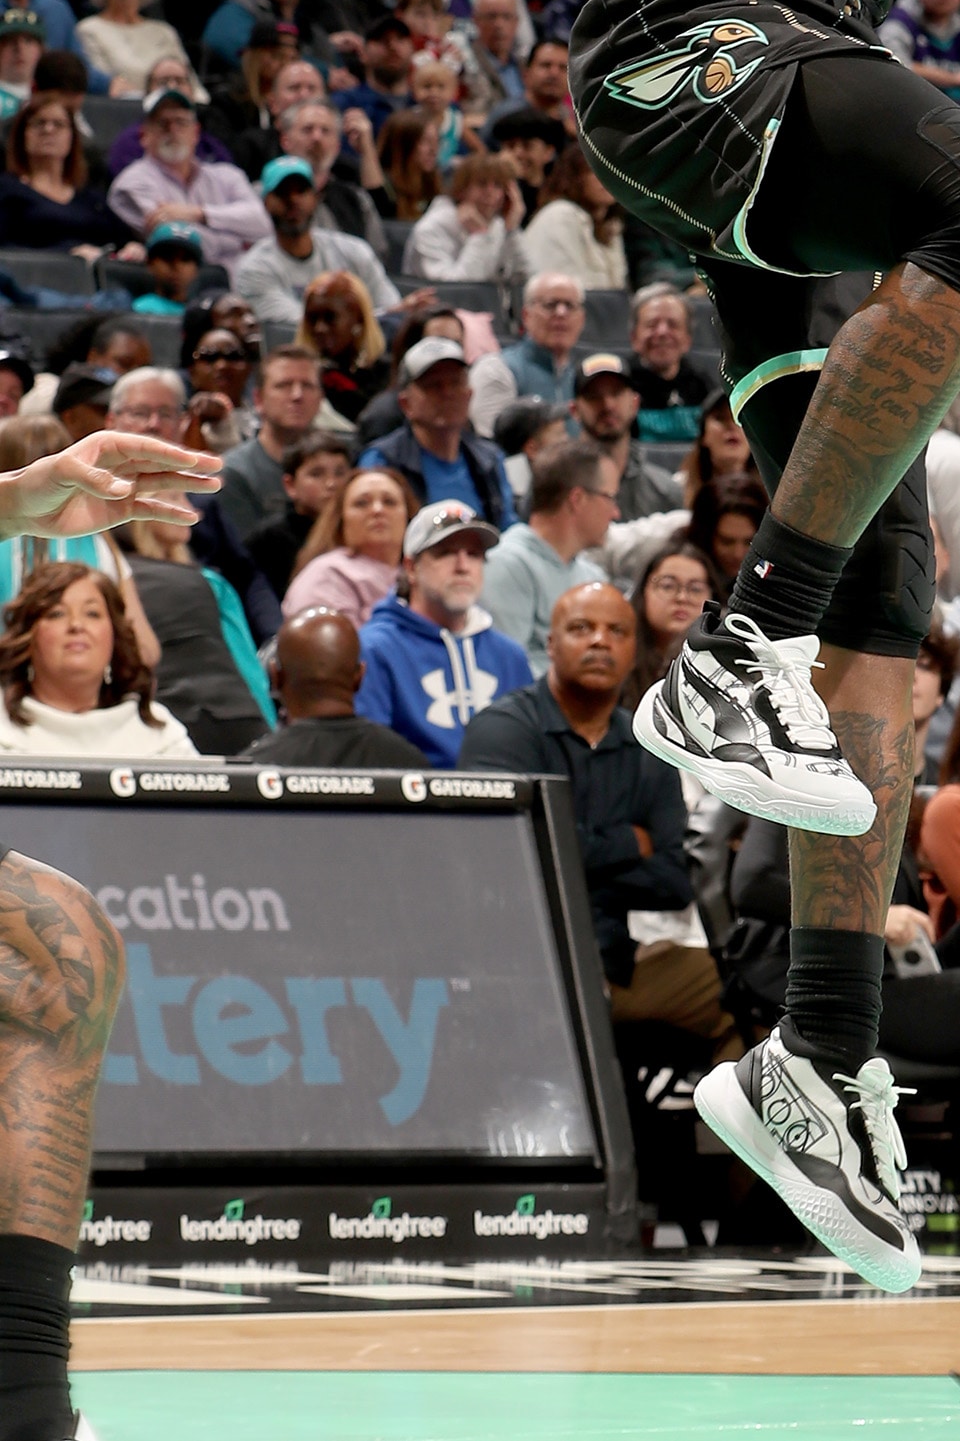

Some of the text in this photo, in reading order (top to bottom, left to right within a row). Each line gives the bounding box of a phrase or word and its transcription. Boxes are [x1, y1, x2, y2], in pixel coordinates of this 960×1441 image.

[139, 773, 230, 791] GATORADE
[286, 776, 375, 795] GATORADE
[429, 779, 516, 799] GATORADE
[180, 1214, 300, 1245] lendingtree
[329, 1212, 446, 1242] lendingtree
[474, 1210, 588, 1239] lendingtree
